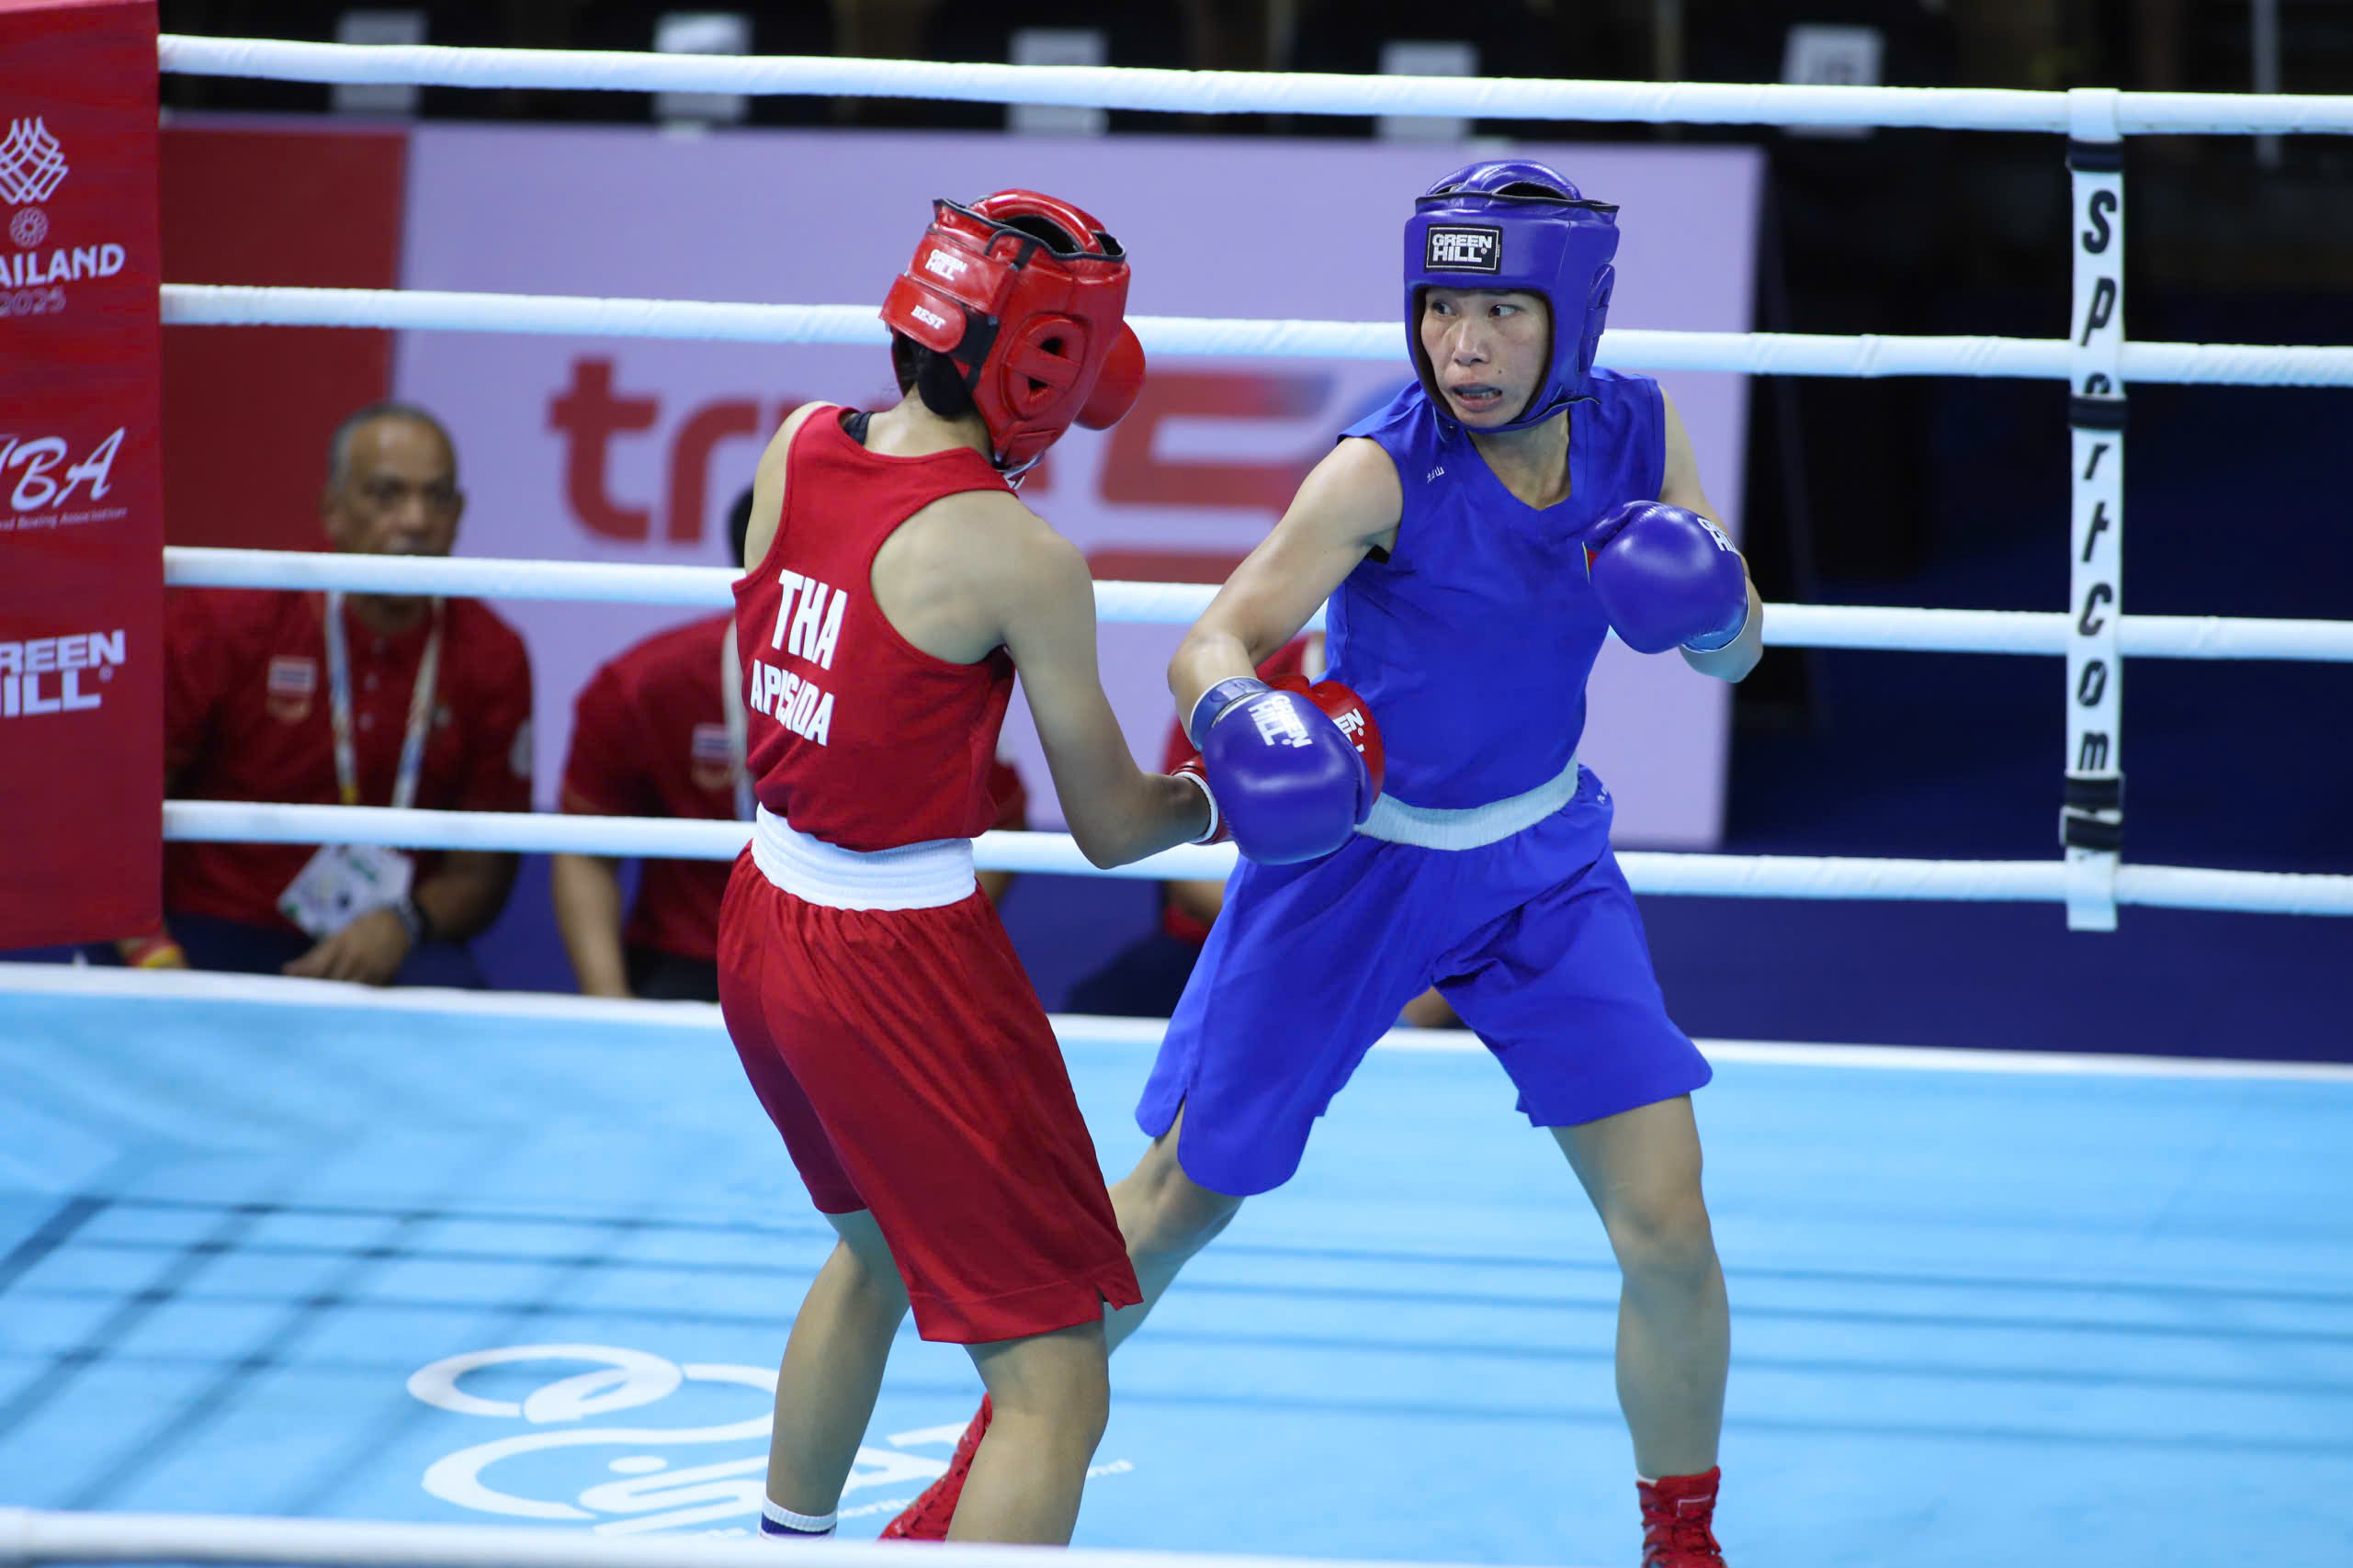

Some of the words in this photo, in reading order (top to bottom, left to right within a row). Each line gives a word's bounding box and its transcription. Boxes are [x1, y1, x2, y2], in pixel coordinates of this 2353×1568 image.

[1431, 233, 1492, 248] GREEN
[1432, 246, 1482, 263] HILL
[925, 257, 956, 281] HILL
[911, 304, 945, 330] BEST
[772, 569, 848, 671] THA
[0, 669, 102, 717] ILL
[750, 659, 835, 747] APISIDA
[1248, 700, 1287, 746] HILL
[1270, 694, 1313, 749] GREEN
